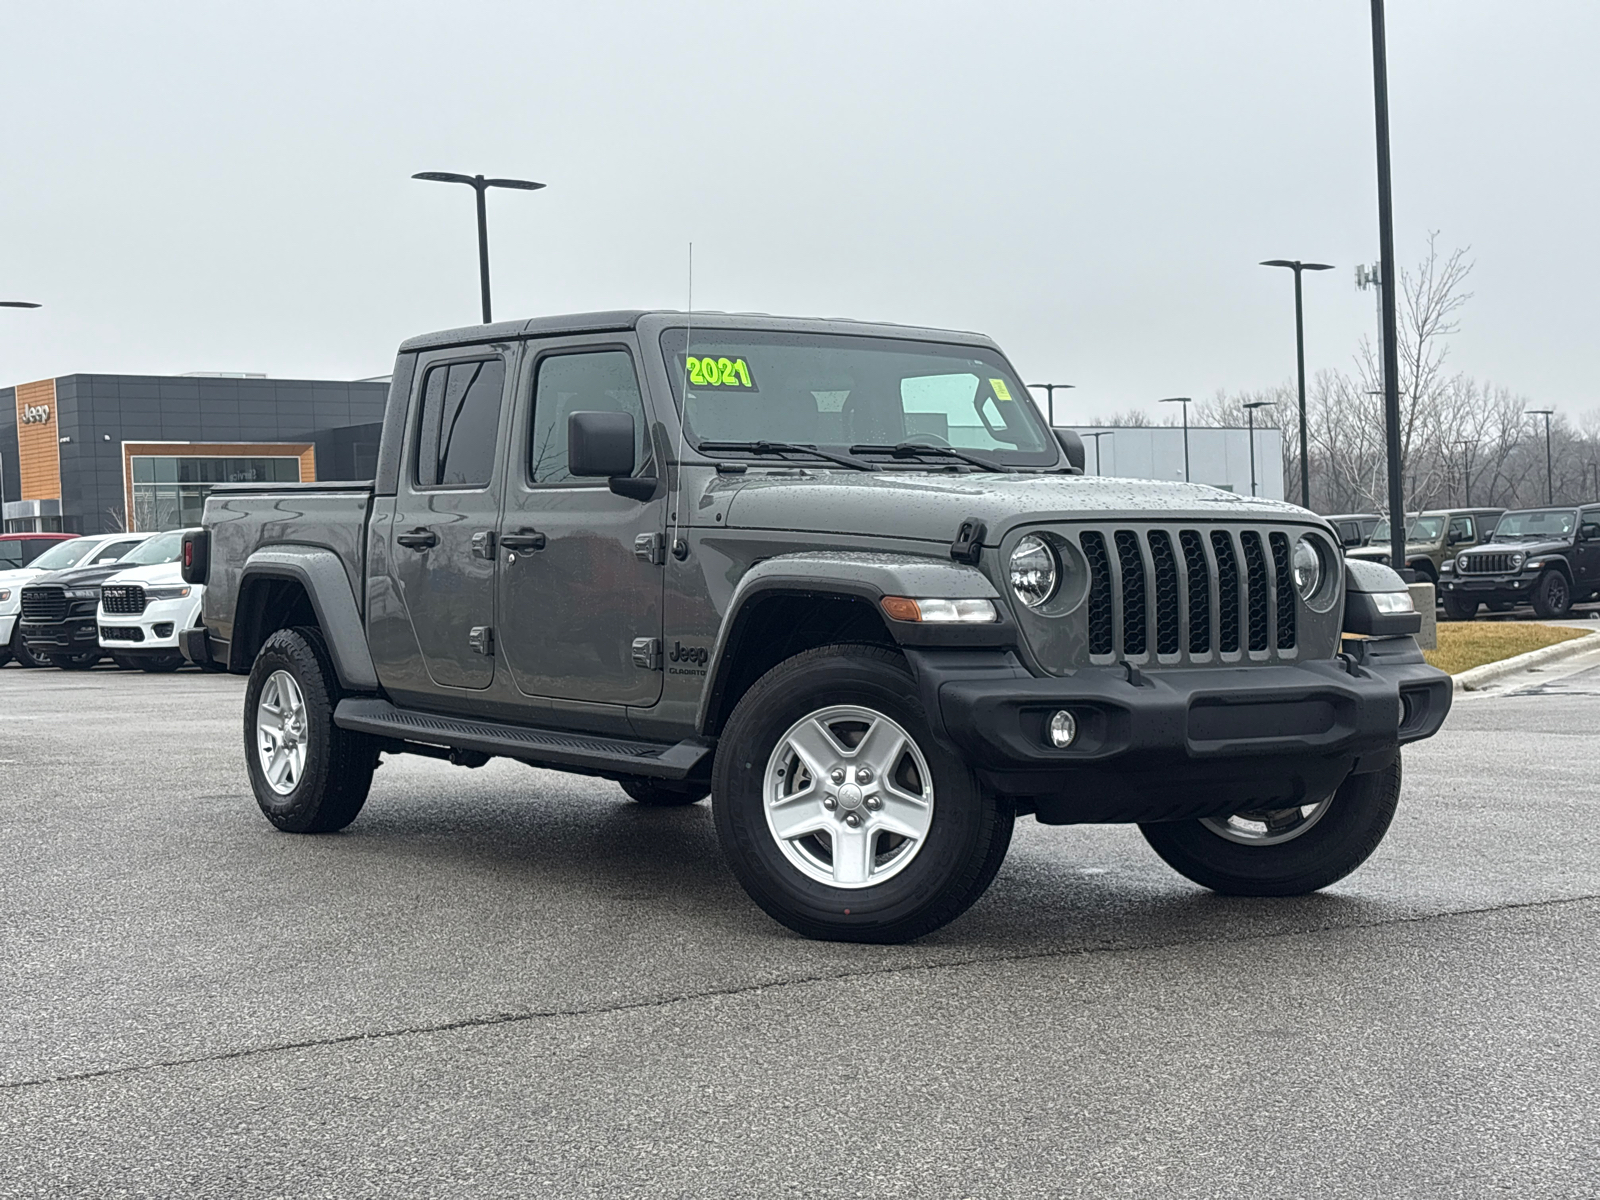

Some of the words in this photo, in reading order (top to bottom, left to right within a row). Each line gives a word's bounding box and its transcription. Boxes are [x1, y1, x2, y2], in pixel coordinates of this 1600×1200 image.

[686, 356, 752, 387] 2021
[22, 403, 50, 425] Jeep
[26, 592, 48, 600] RAM
[103, 590, 126, 598] RAM
[669, 640, 708, 666] Jeep
[669, 667, 707, 676] GLADIATO
